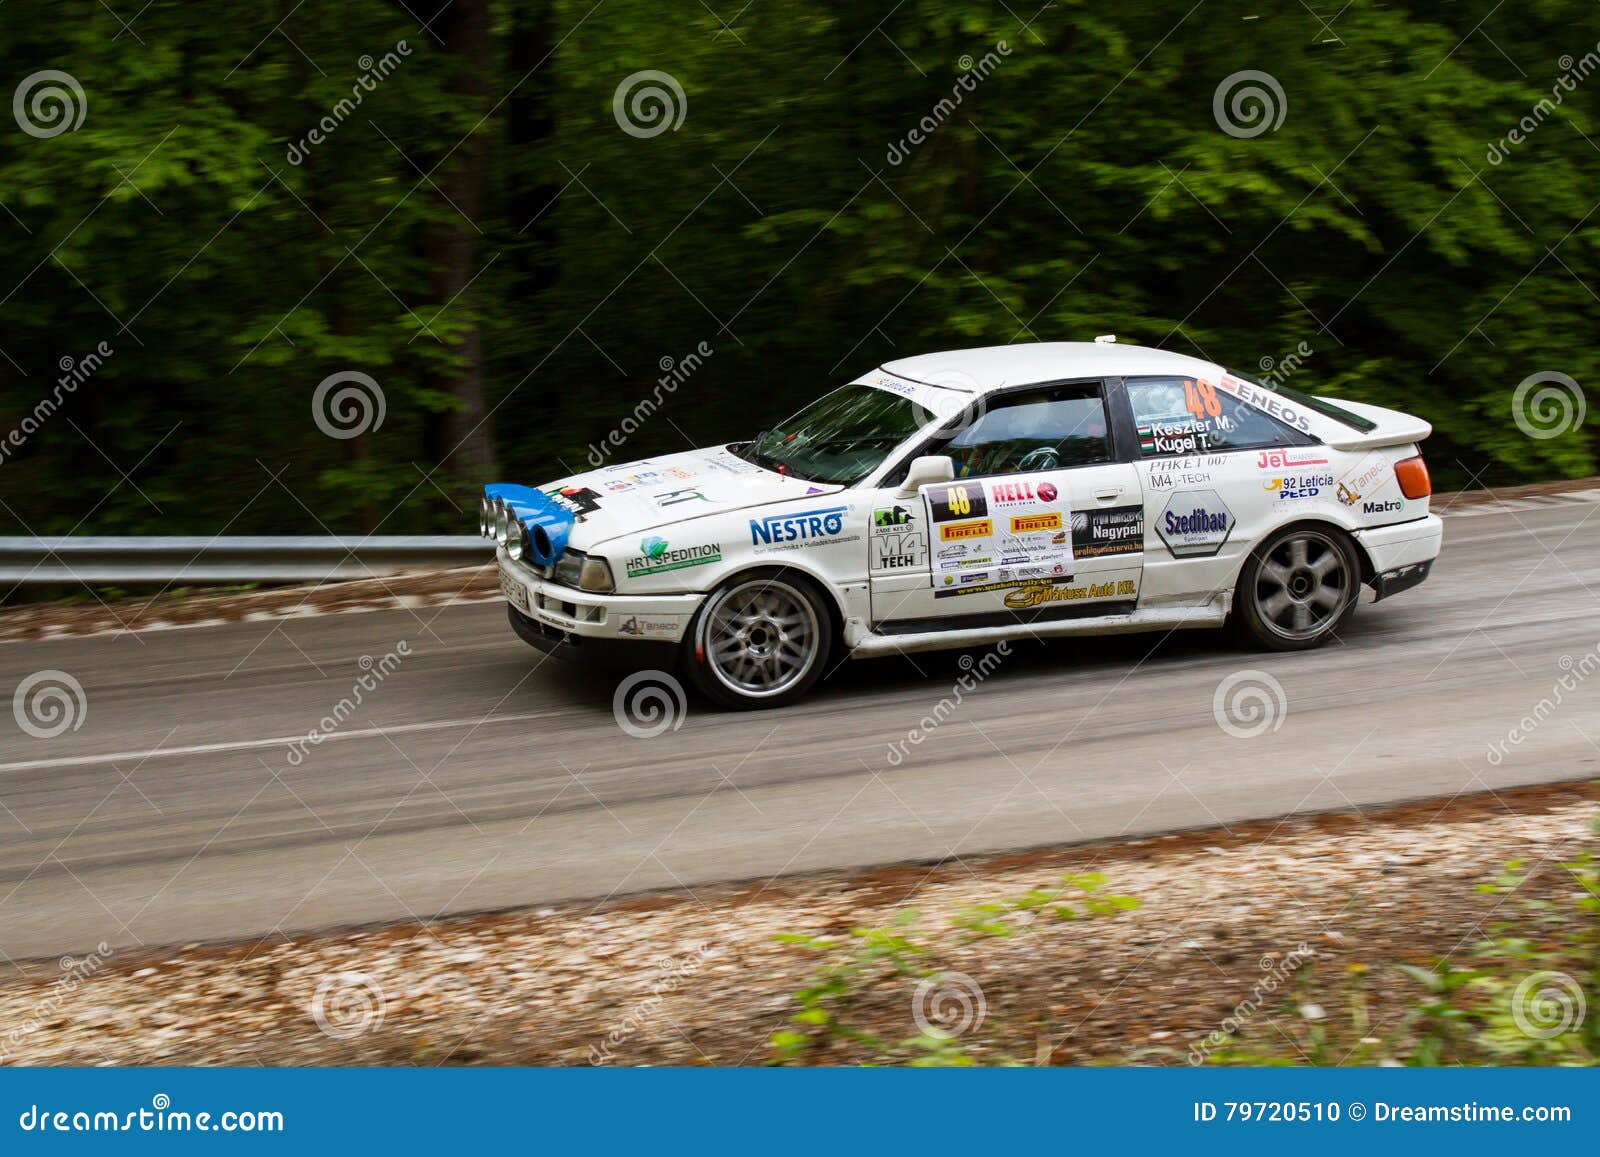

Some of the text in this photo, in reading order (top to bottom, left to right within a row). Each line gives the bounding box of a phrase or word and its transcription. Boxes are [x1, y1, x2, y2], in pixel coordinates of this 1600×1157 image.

[1183, 378, 1222, 419] 48
[1237, 384, 1311, 431] ENEOS
[1151, 415, 1234, 437] Keszler M.
[1154, 433, 1212, 453] Kugel T.
[1151, 474, 1172, 488] M4
[1283, 474, 1334, 489] 92 Leticia
[947, 486, 971, 515] 48
[992, 482, 1034, 503] HELL
[749, 506, 848, 546] NESTRO
[944, 522, 989, 539] PIRELLI
[1015, 515, 1058, 530] PIRELLI
[655, 542, 720, 565] SPEDITION
[871, 532, 927, 570] M4
[881, 555, 913, 568] TECH
